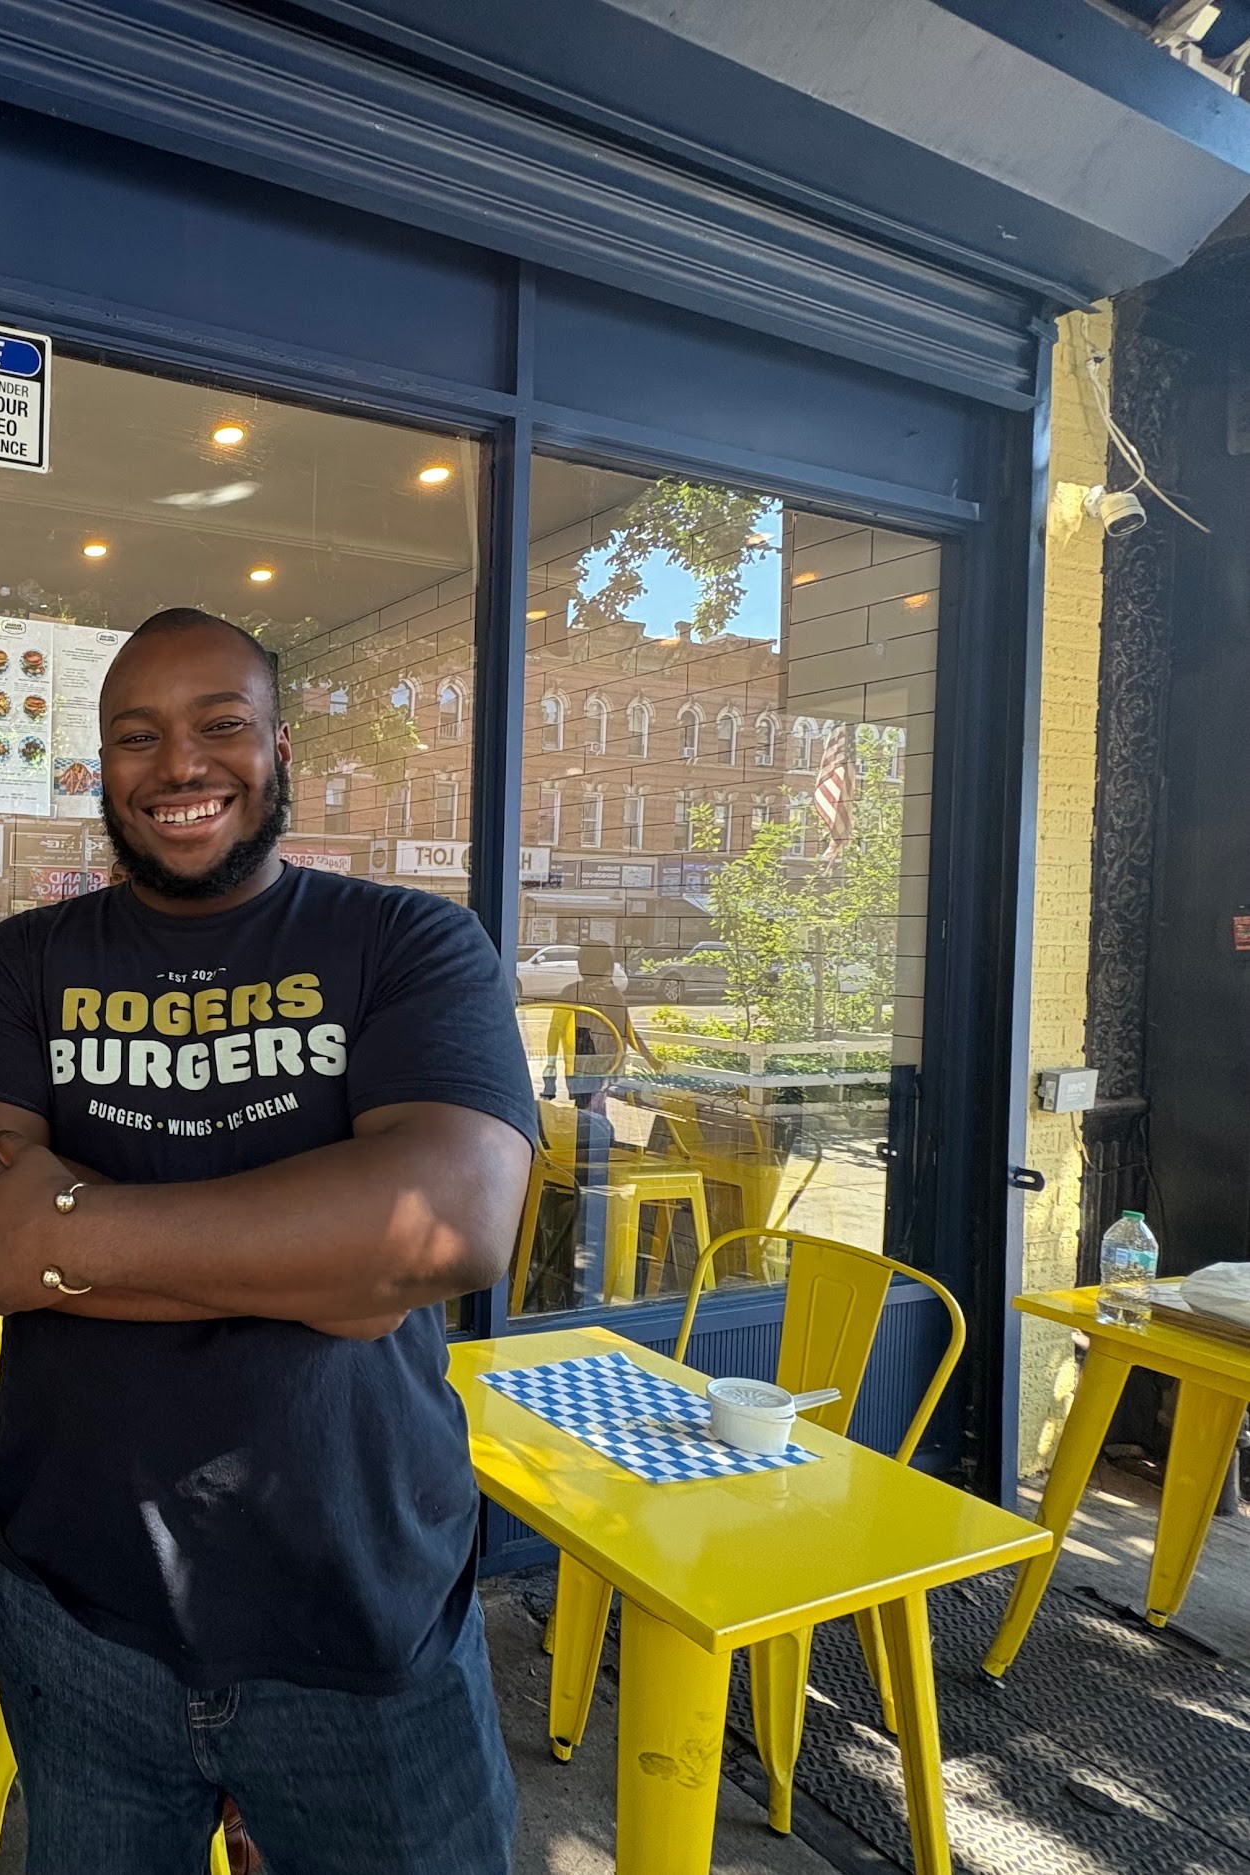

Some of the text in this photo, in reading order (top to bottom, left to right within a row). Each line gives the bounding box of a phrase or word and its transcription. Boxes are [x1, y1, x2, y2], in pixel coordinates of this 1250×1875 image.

[168, 971, 188, 983] EST
[61, 973, 323, 1036] ROGERS
[49, 1023, 347, 1090] BURGERS
[88, 1092, 299, 1137] BURGERS WINGS ICE CREAM
